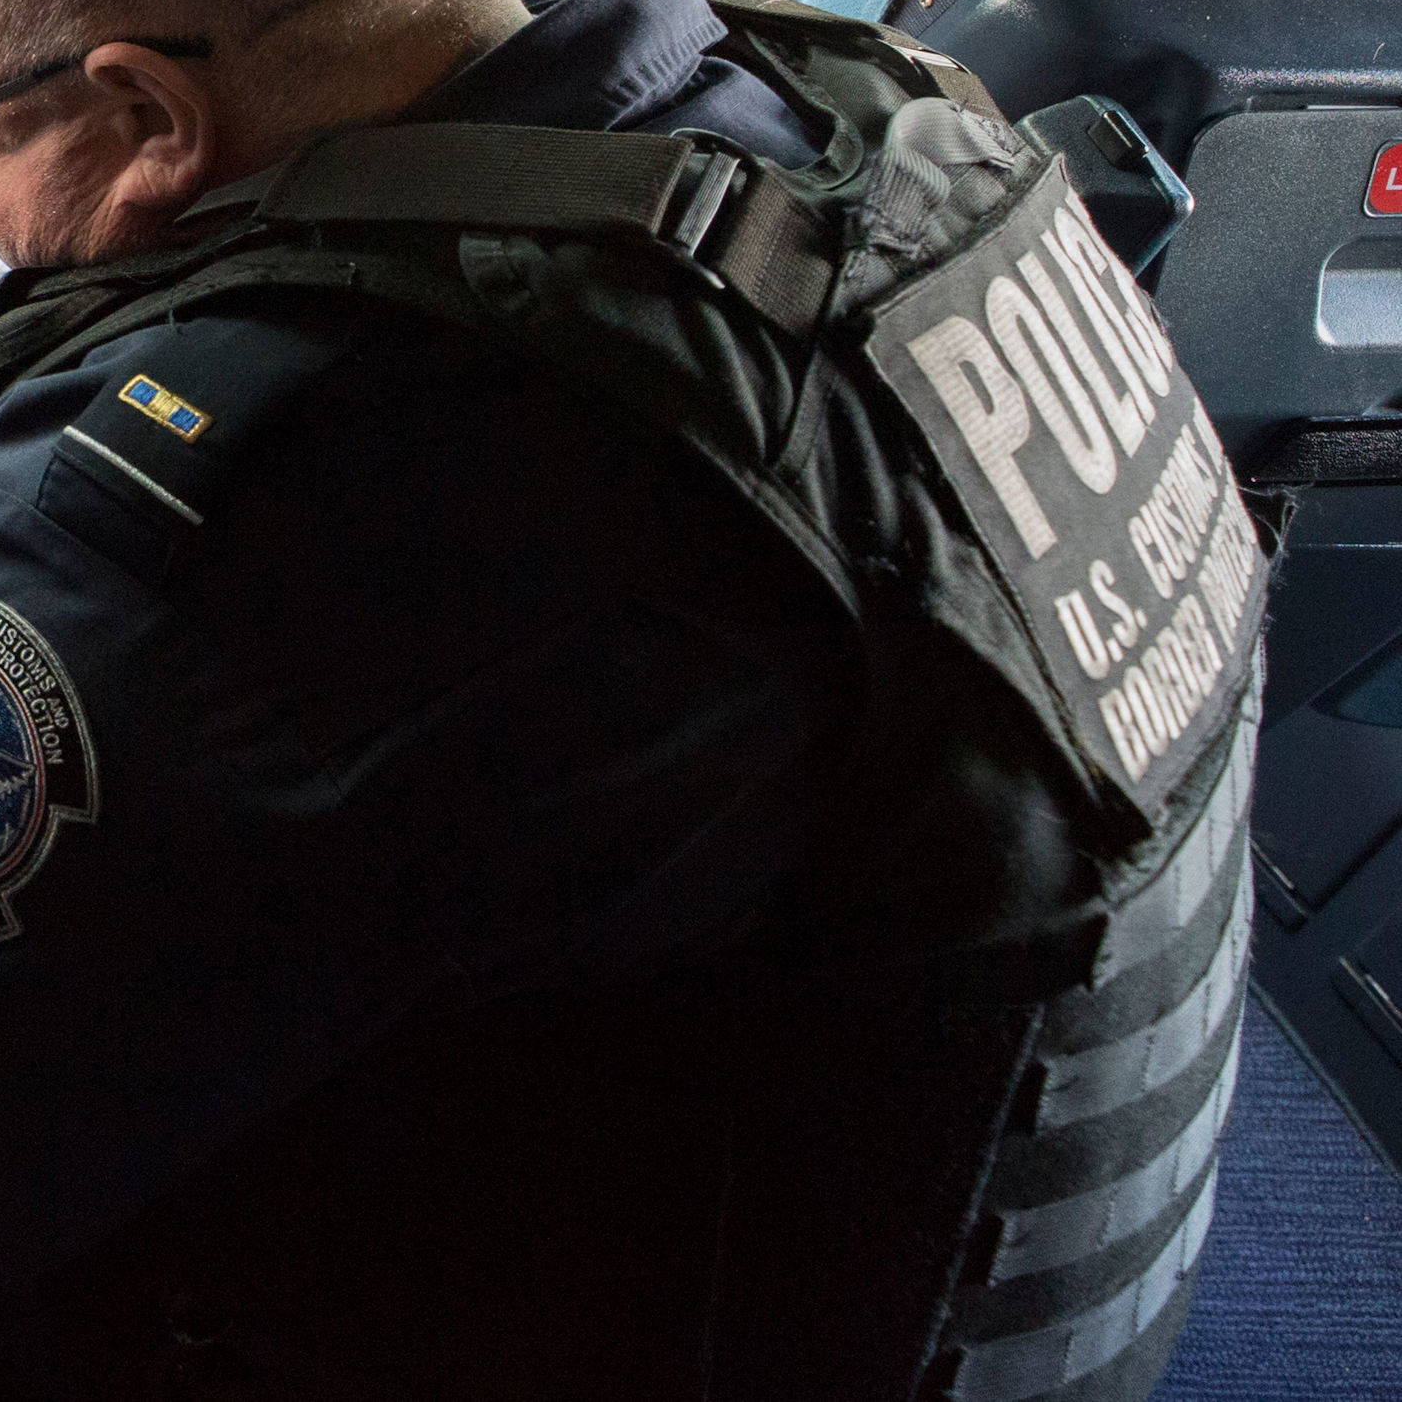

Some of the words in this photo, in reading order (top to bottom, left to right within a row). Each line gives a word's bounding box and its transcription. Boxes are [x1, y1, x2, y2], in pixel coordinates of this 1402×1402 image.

[1054, 559, 1147, 681] U.S.
[1127, 424, 1219, 600] CUSTOMS
[46, 696, 69, 729] AND
[1099, 595, 1223, 784] BORDER
